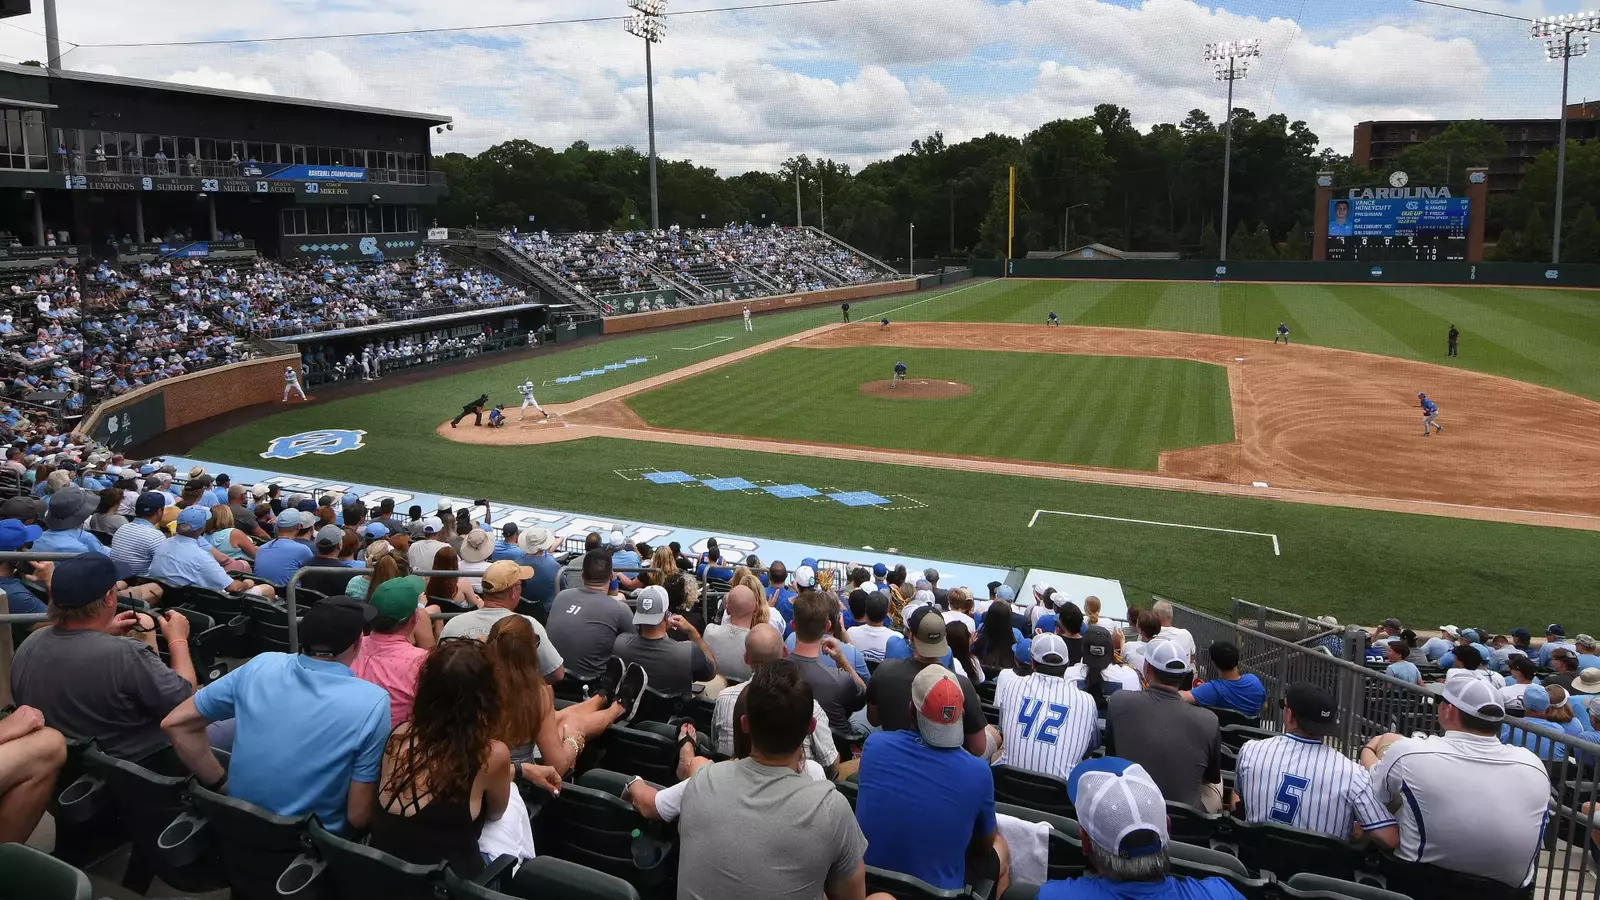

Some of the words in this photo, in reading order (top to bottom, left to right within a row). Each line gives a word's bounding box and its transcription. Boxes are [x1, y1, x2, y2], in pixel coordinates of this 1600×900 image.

[330, 170, 363, 178] CHAMPIONSHIP
[89, 182, 135, 190] LEMONDS
[142, 177, 153, 191] 9
[201, 179, 219, 192] 33
[223, 185, 250, 193] MILLER
[256, 181, 269, 193] 13
[305, 182, 319, 194] 30
[1349, 187, 1452, 199] CAROLINA
[566, 604, 582, 615] 31
[1017, 695, 1070, 746] 42
[1269, 772, 1310, 826] 5
